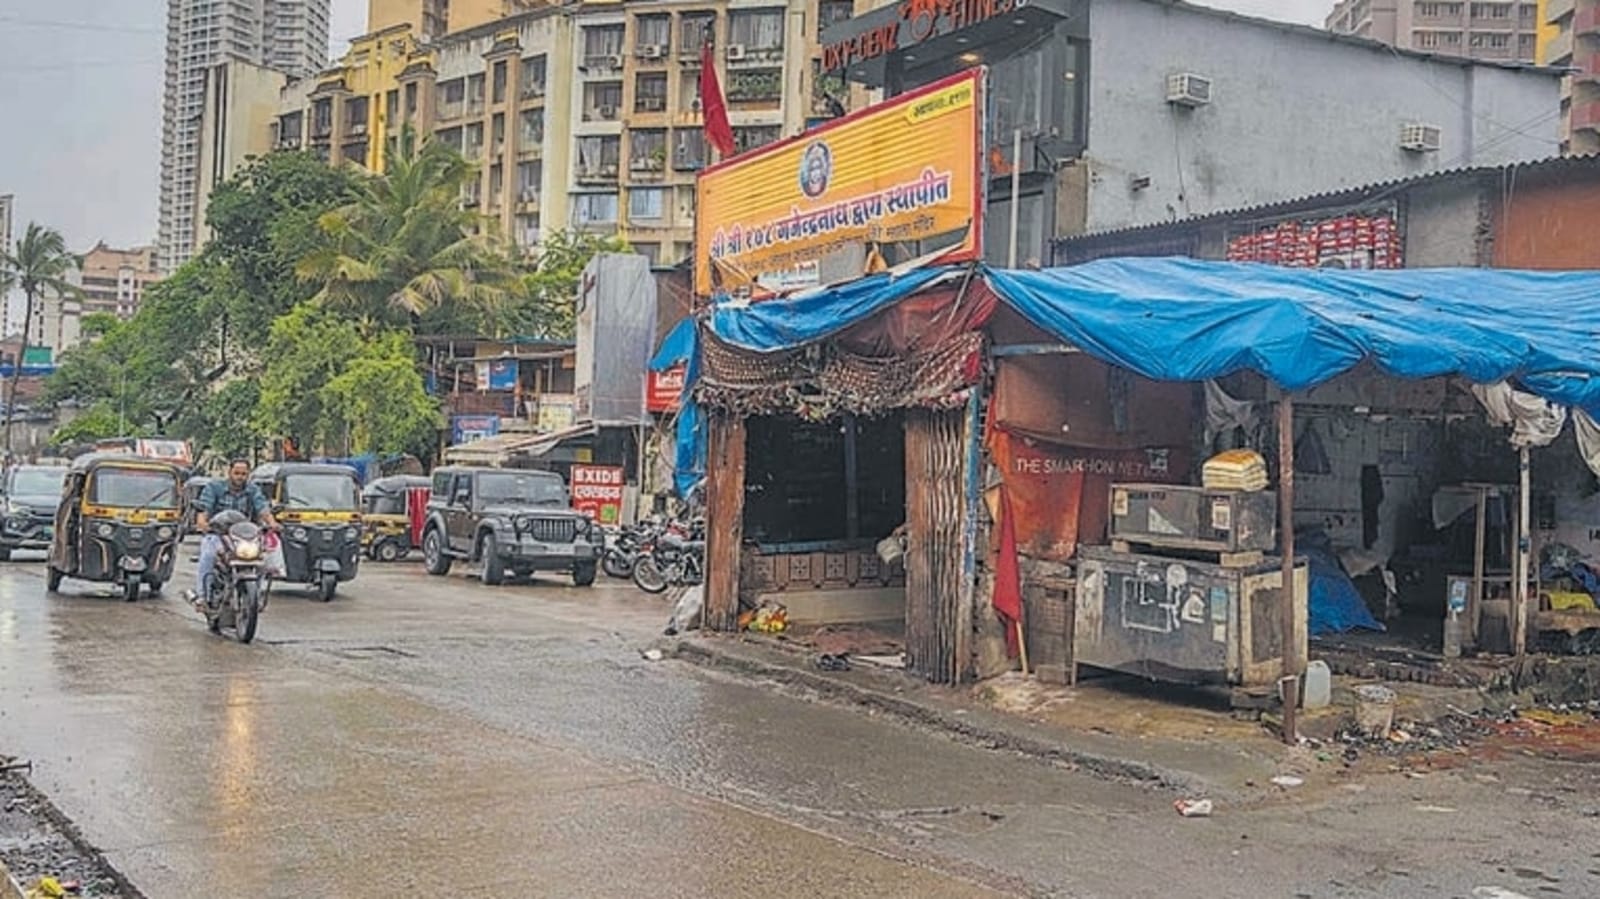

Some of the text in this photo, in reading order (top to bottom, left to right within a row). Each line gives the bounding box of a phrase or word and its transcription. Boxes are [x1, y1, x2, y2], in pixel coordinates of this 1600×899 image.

[711, 228, 725, 258] श्री
[728, 224, 742, 254] श्री
[1016, 457, 1041, 474] THE
[575, 467, 622, 483] EXIDE
